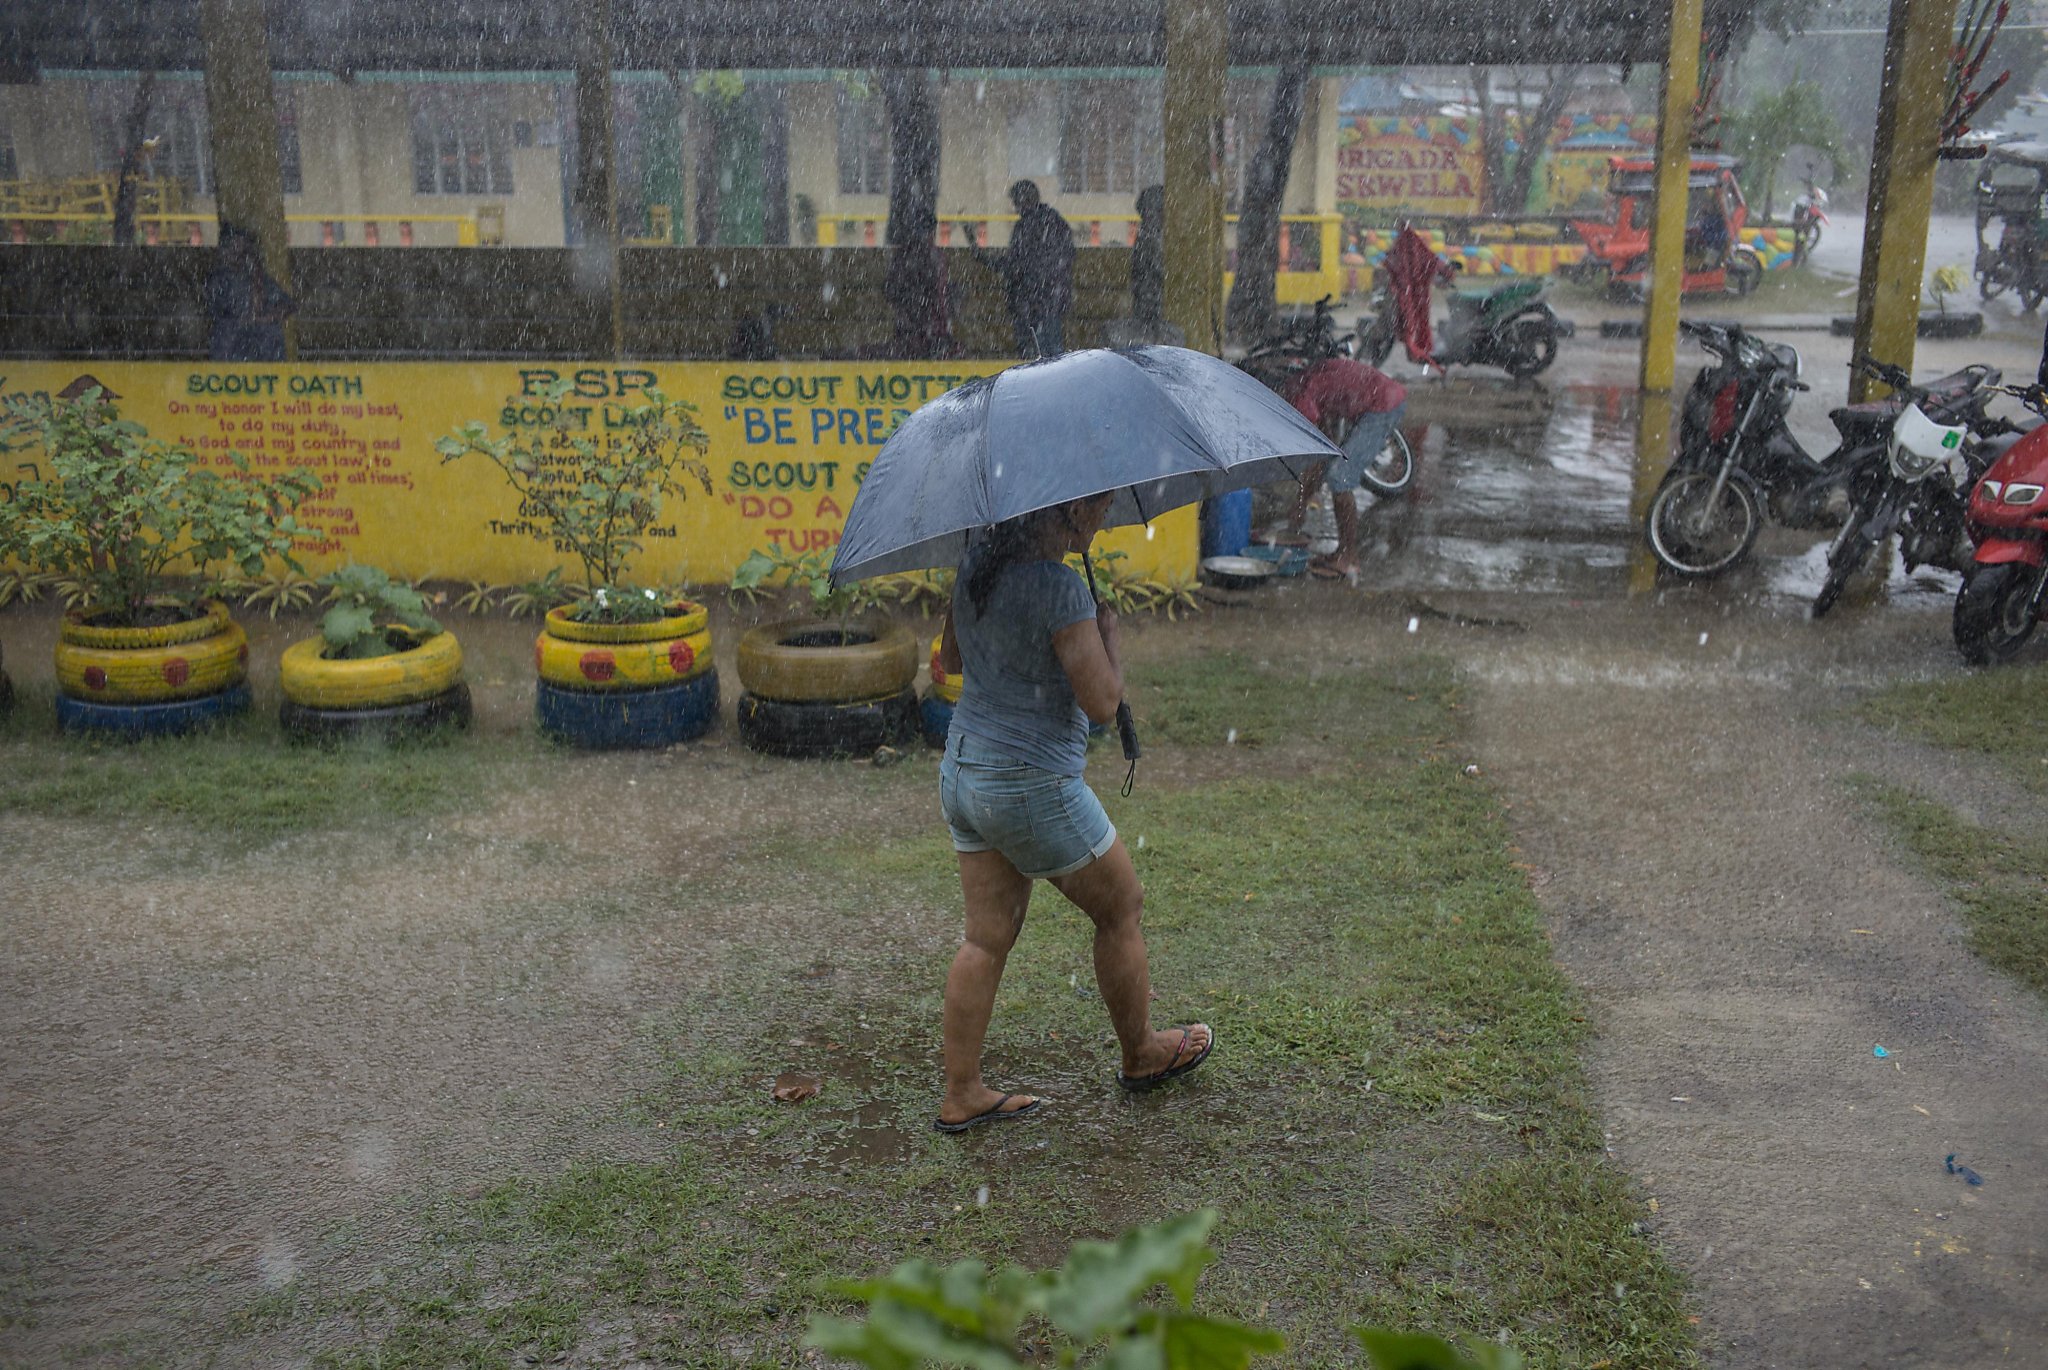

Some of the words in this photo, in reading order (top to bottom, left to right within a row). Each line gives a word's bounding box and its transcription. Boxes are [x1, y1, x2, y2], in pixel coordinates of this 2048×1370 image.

[187, 374, 279, 396] SCOUT
[288, 374, 364, 396] OATH
[518, 369, 658, 398] BSP
[722, 374, 843, 401] SCOUT
[168, 400, 190, 415] On
[195, 404, 218, 419] my
[221, 400, 265, 415] honor
[270, 401, 280, 415] I
[283, 399, 312, 415] will
[318, 402, 337, 415] do
[341, 404, 363, 420] my
[366, 402, 404, 422] best,
[219, 418, 236, 432] to
[242, 418, 264, 432] do
[271, 421, 295, 436] my
[301, 418, 347, 437] duty,
[179, 434, 195, 448] to
[235, 435, 265, 449] and
[271, 438, 296, 454] my
[302, 437, 368, 457] country
[372, 436, 401, 450] and
[215, 453, 251, 467] ob
[255, 453, 280, 466] the
[285, 453, 328, 467] scout
[374, 452, 392, 468] to
[322, 471, 339, 484] at
[347, 471, 366, 484] all
[728, 460, 840, 488] SCOUT
[302, 506, 354, 522] strong
[815, 495, 843, 520] A
[330, 521, 360, 537] and
[648, 524, 677, 538] and
[290, 538, 346, 556] traight.
